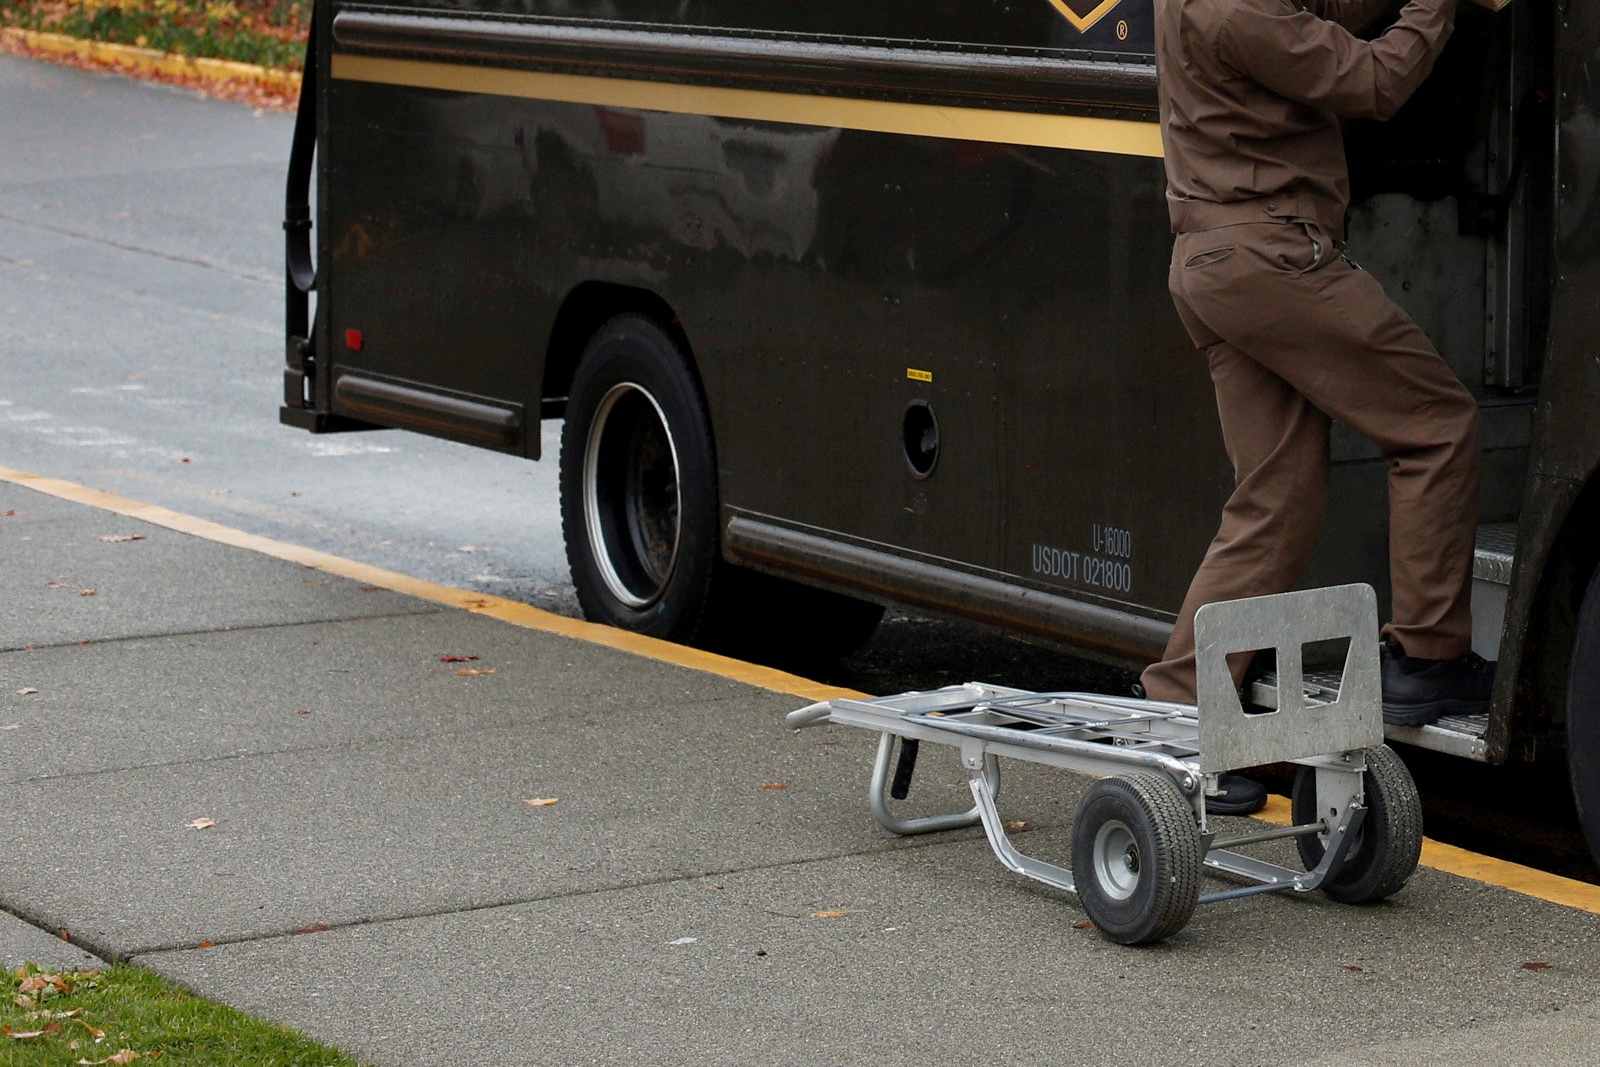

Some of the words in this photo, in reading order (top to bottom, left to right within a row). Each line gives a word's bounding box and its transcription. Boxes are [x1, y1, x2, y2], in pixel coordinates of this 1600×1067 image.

[1093, 523, 1131, 559] U-16000
[1032, 544, 1080, 581] USDOT
[1083, 556, 1132, 593] 021800
